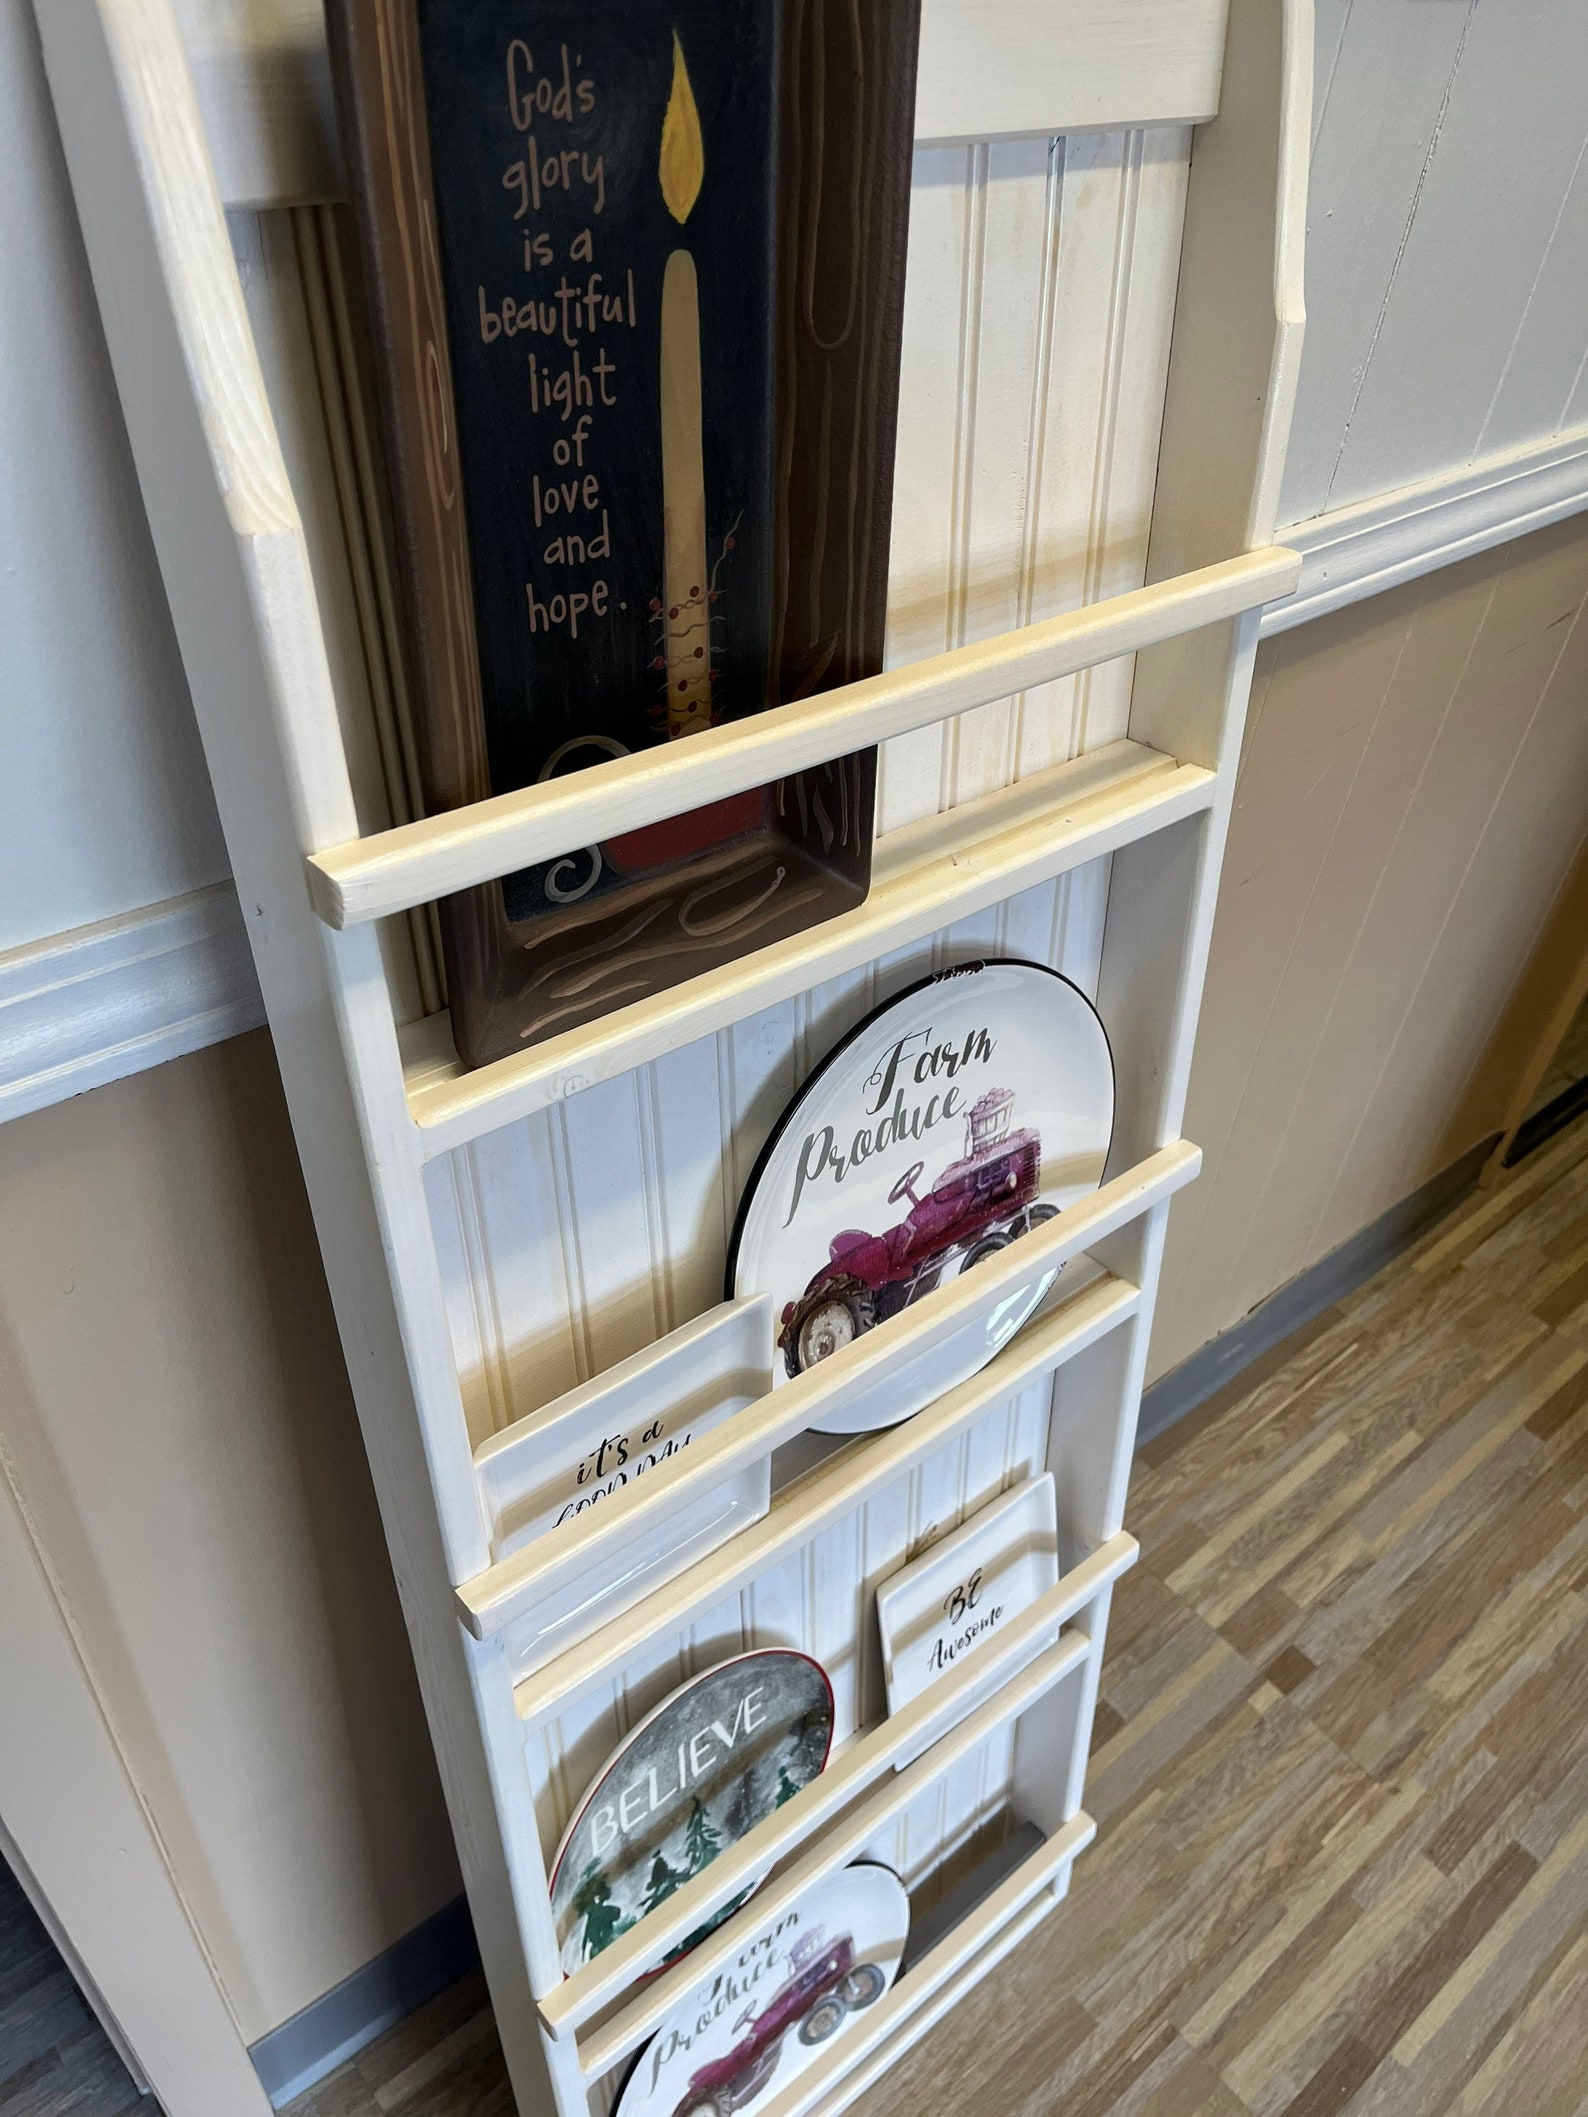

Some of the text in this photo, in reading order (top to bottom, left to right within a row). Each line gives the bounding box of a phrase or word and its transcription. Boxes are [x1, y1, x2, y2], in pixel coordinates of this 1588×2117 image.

[506, 39, 596, 132] God's
[502, 135, 605, 220] glory
[523, 228, 593, 272] is a
[478, 268, 636, 347] beautiful
[528, 348, 617, 421] light
[553, 414, 593, 467] of
[532, 474, 599, 528] love
[543, 508, 610, 566] and
[525, 579, 627, 639] hope.
[863, 1027, 998, 1115] Farm
[782, 1087, 967, 1230] Produce
[576, 1420, 664, 1485] it's a
[944, 1567, 983, 1625] BE
[927, 1605, 1004, 1672] Awesome
[589, 1687, 767, 1857] BELIEVE
